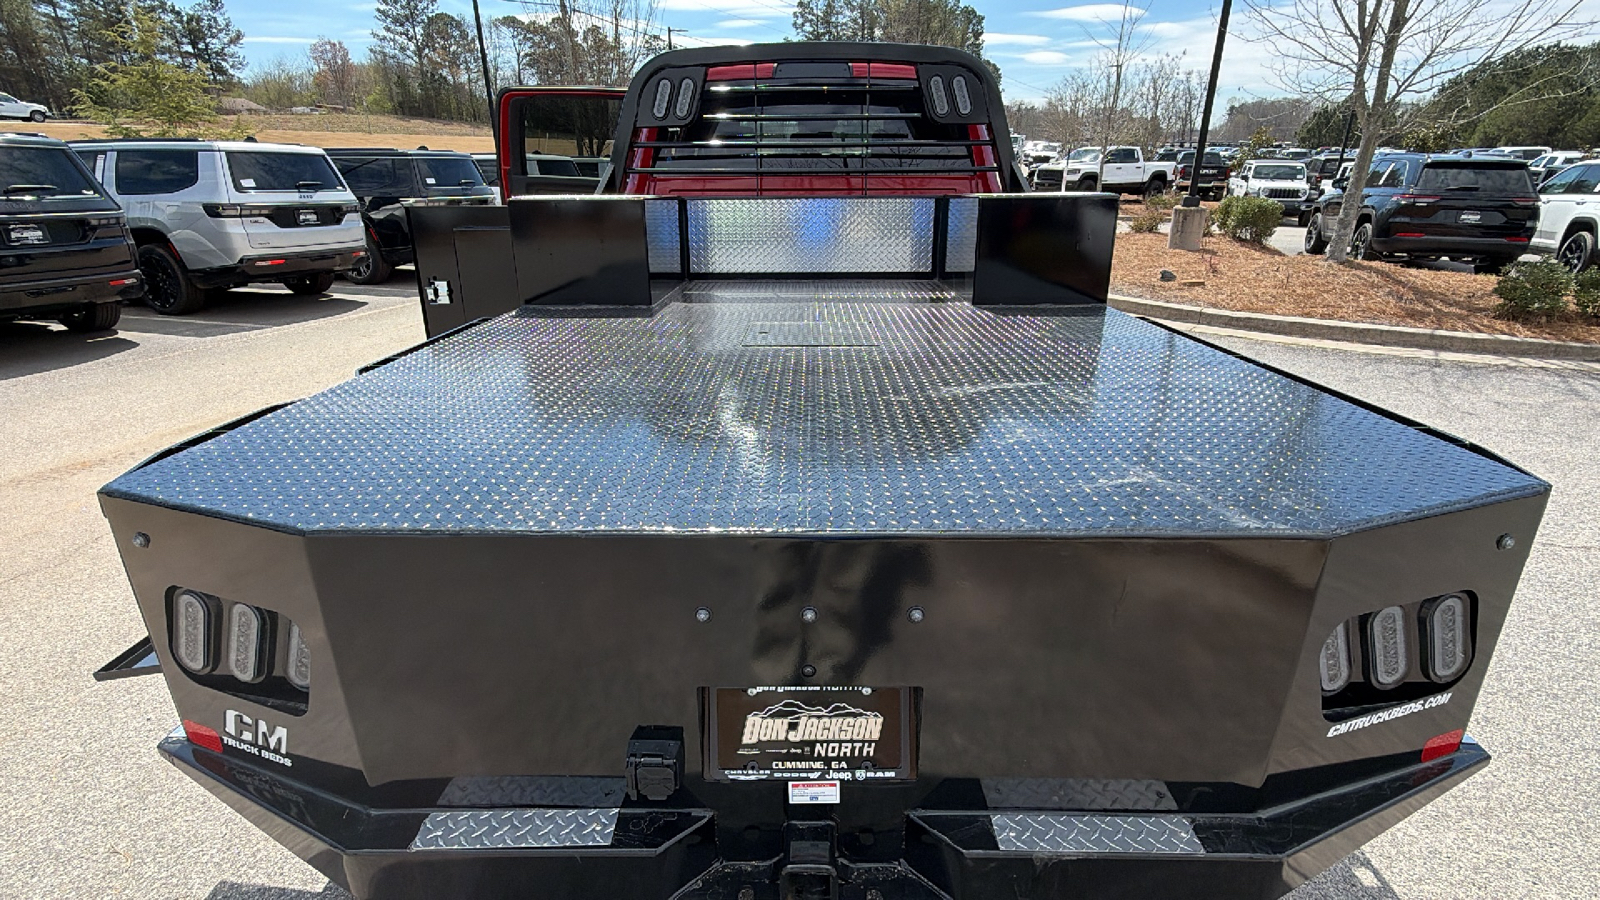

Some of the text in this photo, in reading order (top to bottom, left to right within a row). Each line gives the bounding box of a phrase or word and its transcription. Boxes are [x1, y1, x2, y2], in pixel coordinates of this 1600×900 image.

[1326, 692, 1453, 738] CMTRUCKBEDS.COM
[225, 709, 288, 754] CM
[787, 716, 884, 742] JACKSON
[222, 735, 292, 767] TRUCK BEDS
[814, 743, 876, 757] NORTH
[825, 770, 852, 780] Jeep
[831, 761, 848, 769] GA
